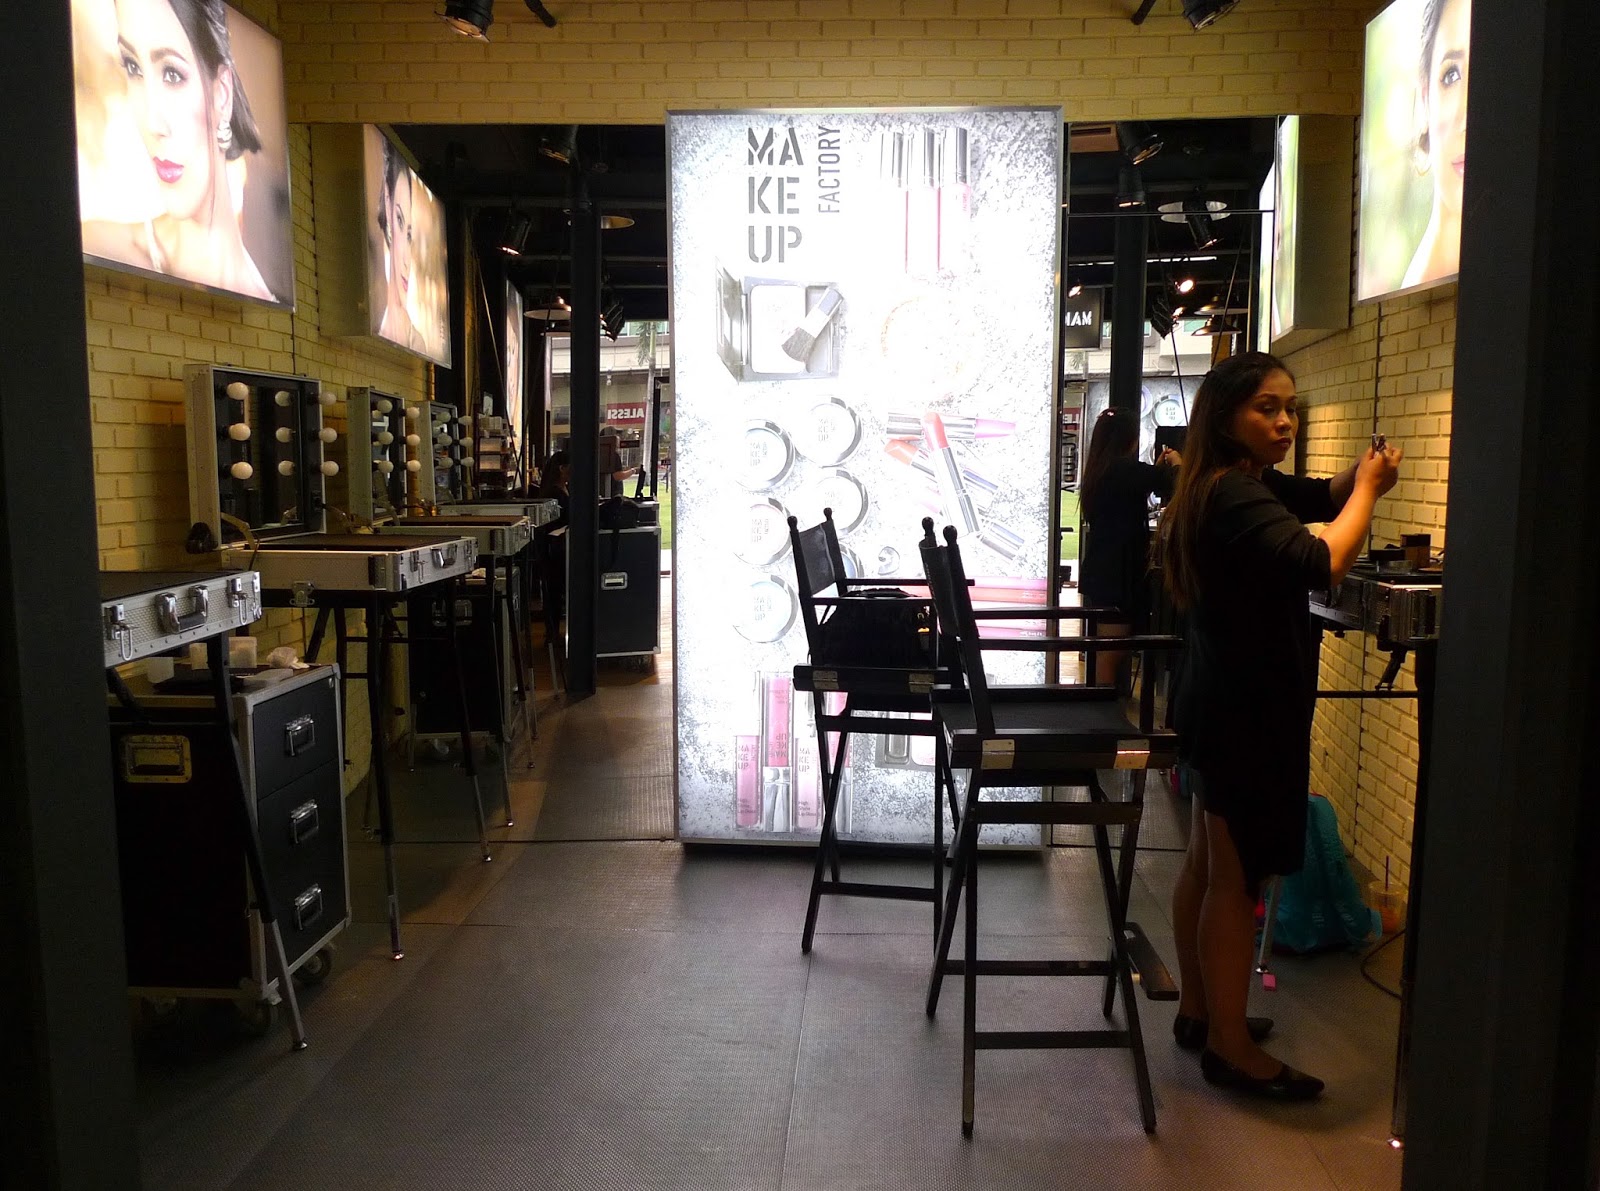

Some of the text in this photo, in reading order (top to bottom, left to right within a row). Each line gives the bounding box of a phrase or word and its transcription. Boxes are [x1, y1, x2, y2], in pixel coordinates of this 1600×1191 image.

[747, 127, 804, 166] MA
[817, 125, 841, 213] FACTORY
[748, 176, 800, 214] KE
[748, 225, 802, 263] UP
